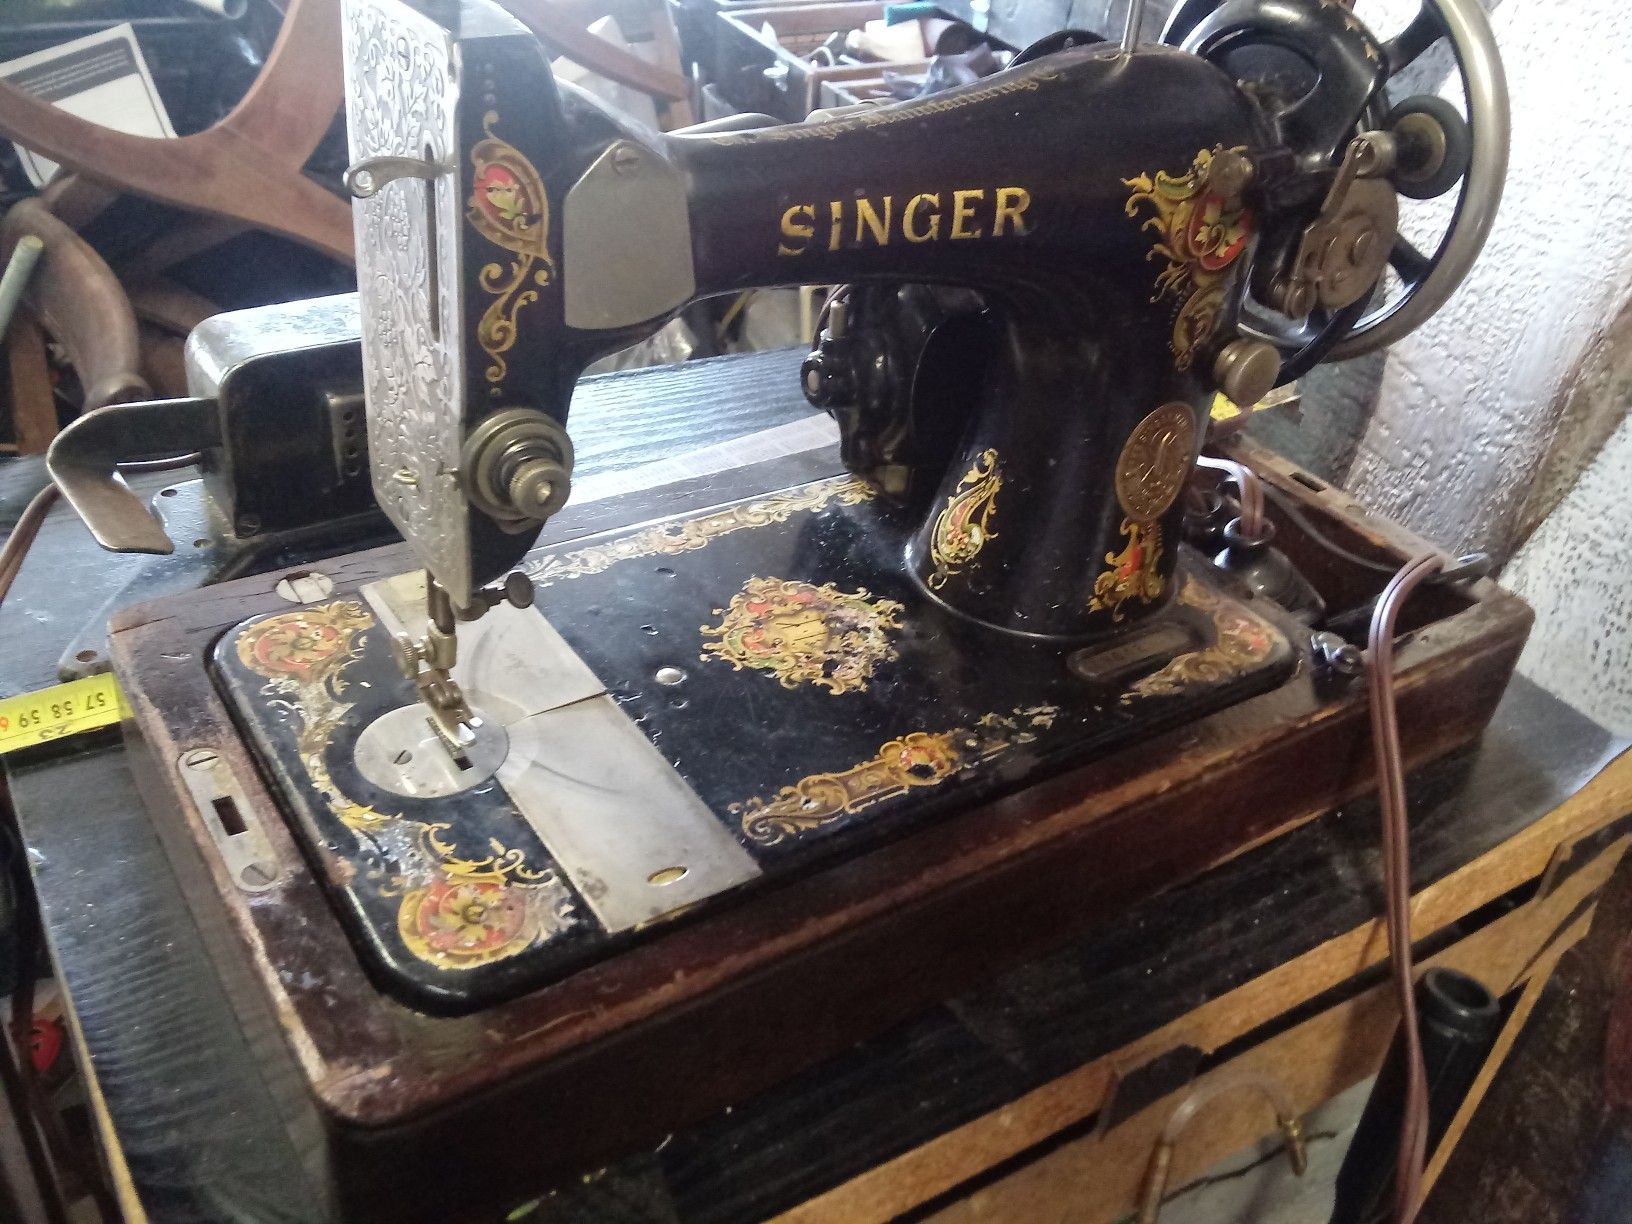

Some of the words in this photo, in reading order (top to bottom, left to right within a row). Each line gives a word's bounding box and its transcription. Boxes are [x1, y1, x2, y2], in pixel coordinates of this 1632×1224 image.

[778, 186, 1032, 256] SINGER
[50, 700, 74, 719] 58
[85, 692, 106, 710] 57
[0, 716, 9, 732] 6
[18, 709, 41, 728] 59
